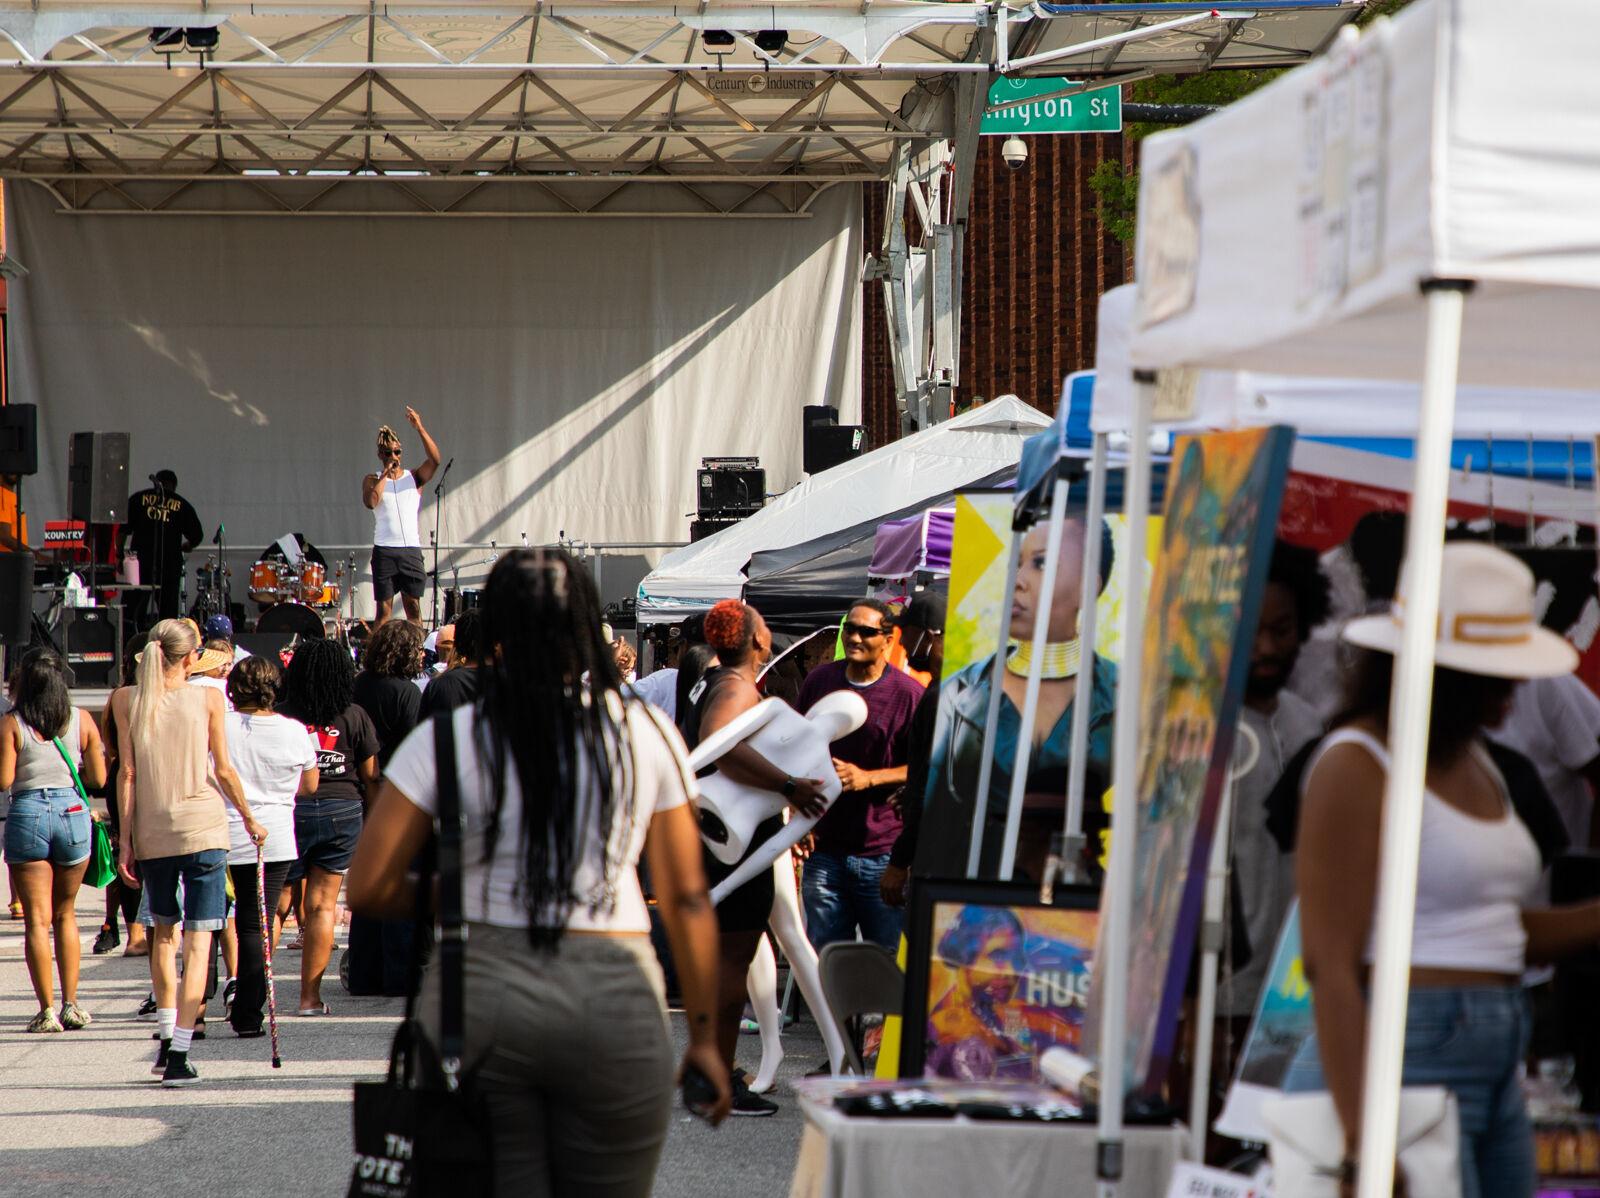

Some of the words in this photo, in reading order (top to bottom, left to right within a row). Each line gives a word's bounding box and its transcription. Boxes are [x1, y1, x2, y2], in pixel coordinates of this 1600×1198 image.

[707, 75, 747, 93] Century
[766, 75, 814, 90] Industries
[986, 94, 1073, 126] ington
[1090, 98, 1109, 116] St
[44, 530, 85, 541] KOUNTRY
[324, 753, 346, 763] That
